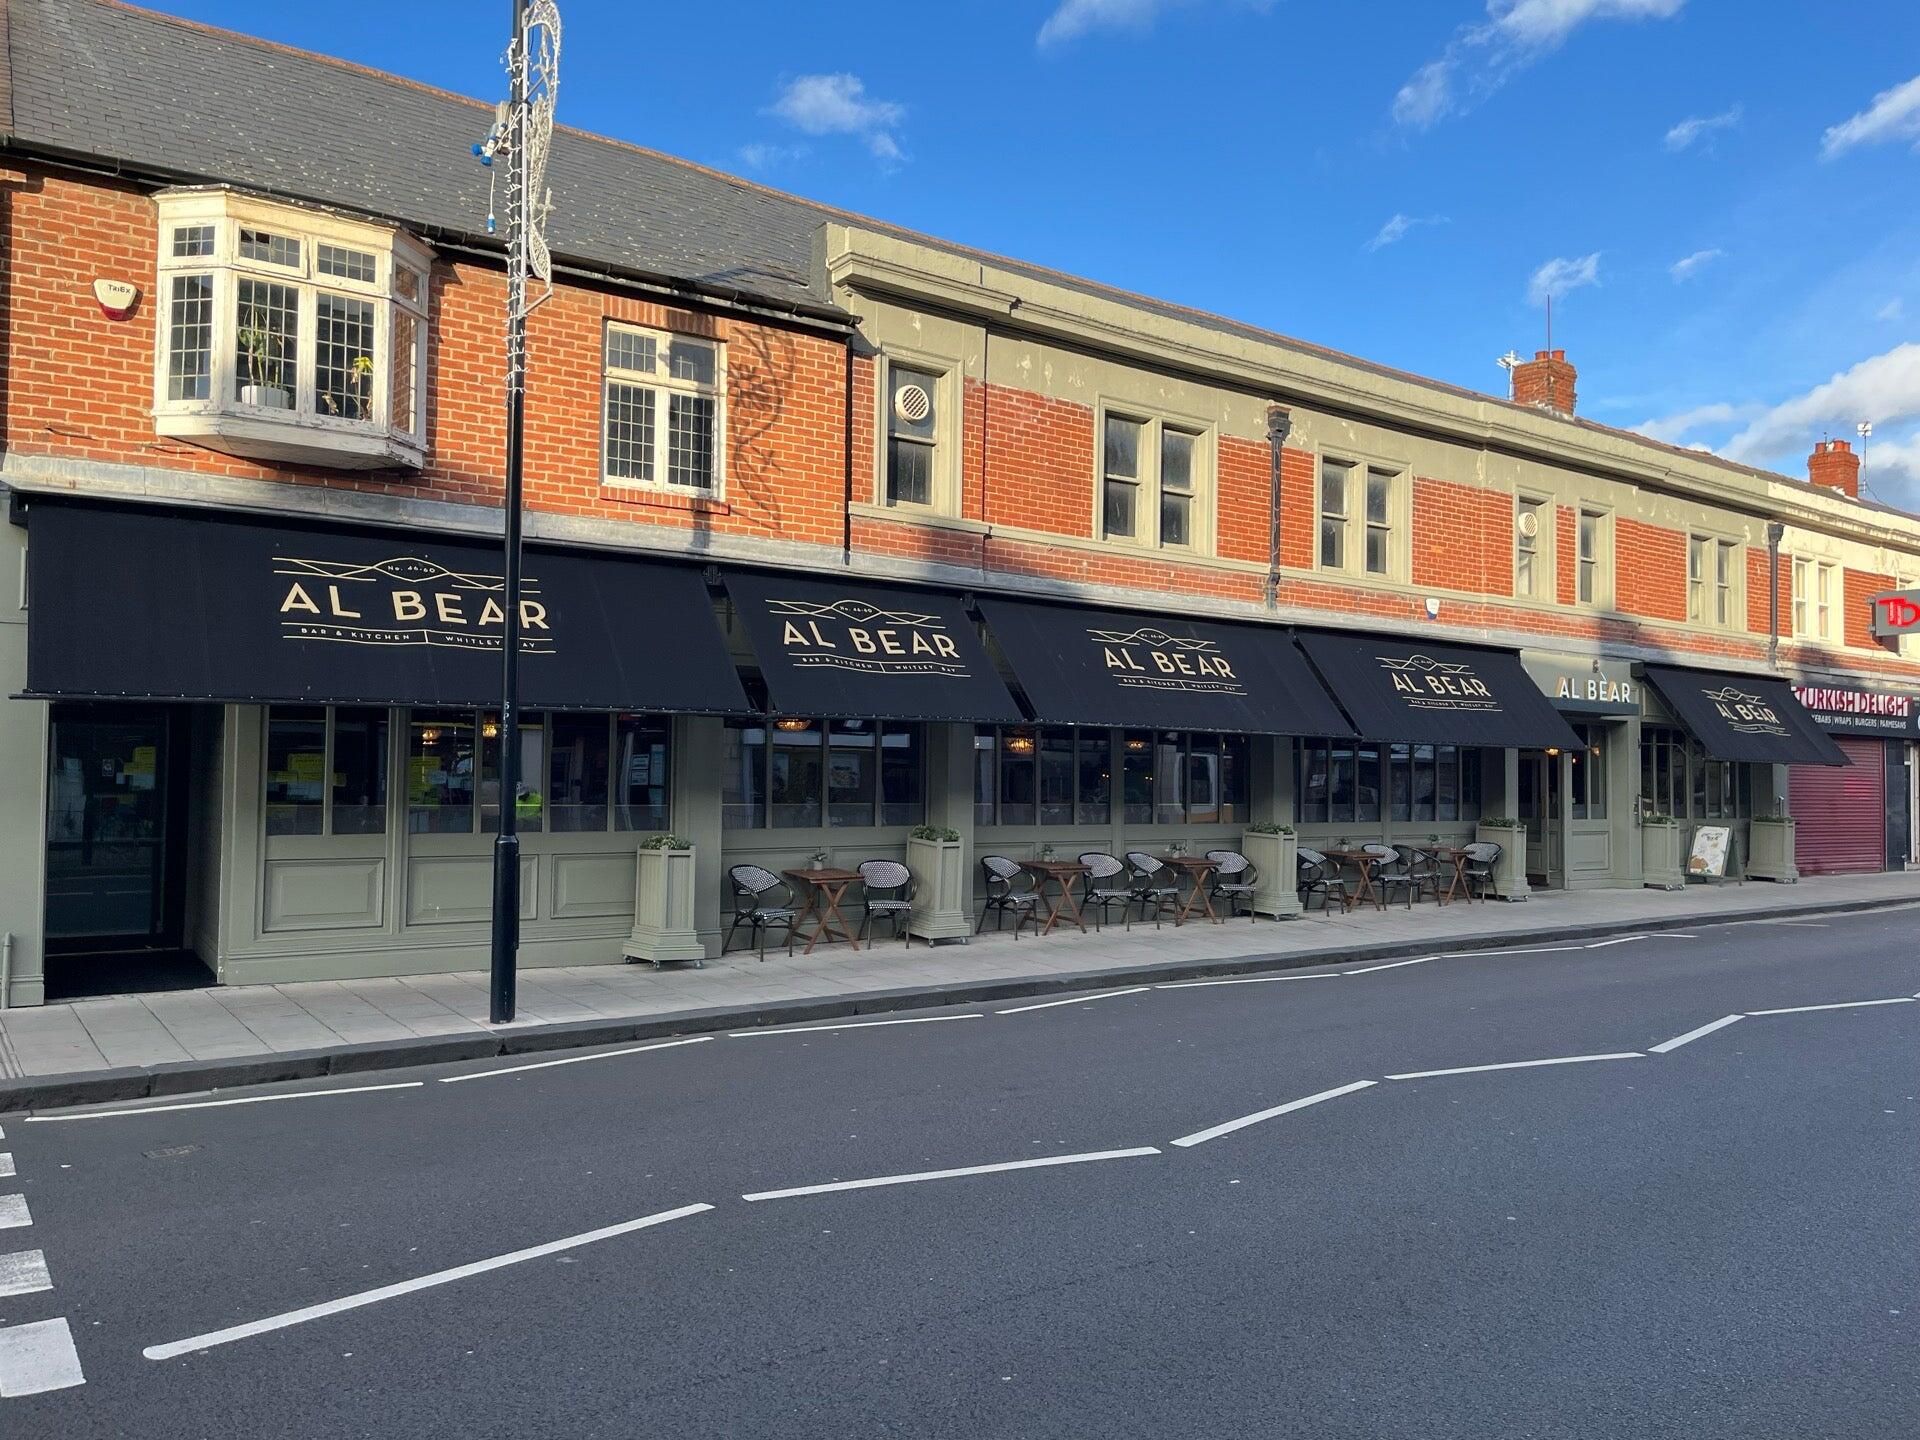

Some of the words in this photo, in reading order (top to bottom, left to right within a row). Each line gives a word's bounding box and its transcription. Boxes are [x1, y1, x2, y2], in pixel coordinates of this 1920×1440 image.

[279, 581, 361, 619] AL
[391, 589, 551, 630] BEAR
[301, 627, 327, 636] BAR
[351, 631, 411, 641] KITCHEN
[445, 635, 501, 646] WHITLEY
[783, 619, 837, 648] AL
[848, 627, 961, 659] BEAR
[835, 659, 873, 669] KITCHEN
[1104, 646, 1146, 671] AL
[1150, 651, 1236, 679] BEAR
[1391, 671, 1425, 694] AL
[1424, 675, 1492, 697] BEAR
[1559, 677, 1580, 699] AL
[1587, 679, 1631, 703] BEAR
[1715, 702, 1739, 721] AL
[1734, 704, 1781, 724] BEAR
[1793, 685, 1856, 712] TURKISH
[1858, 691, 1913, 717] DELIGHT
[1834, 716, 1852, 726] WRAPS
[1854, 717, 1877, 728] BURGERS
[1880, 720, 1907, 730] PARMESANS
